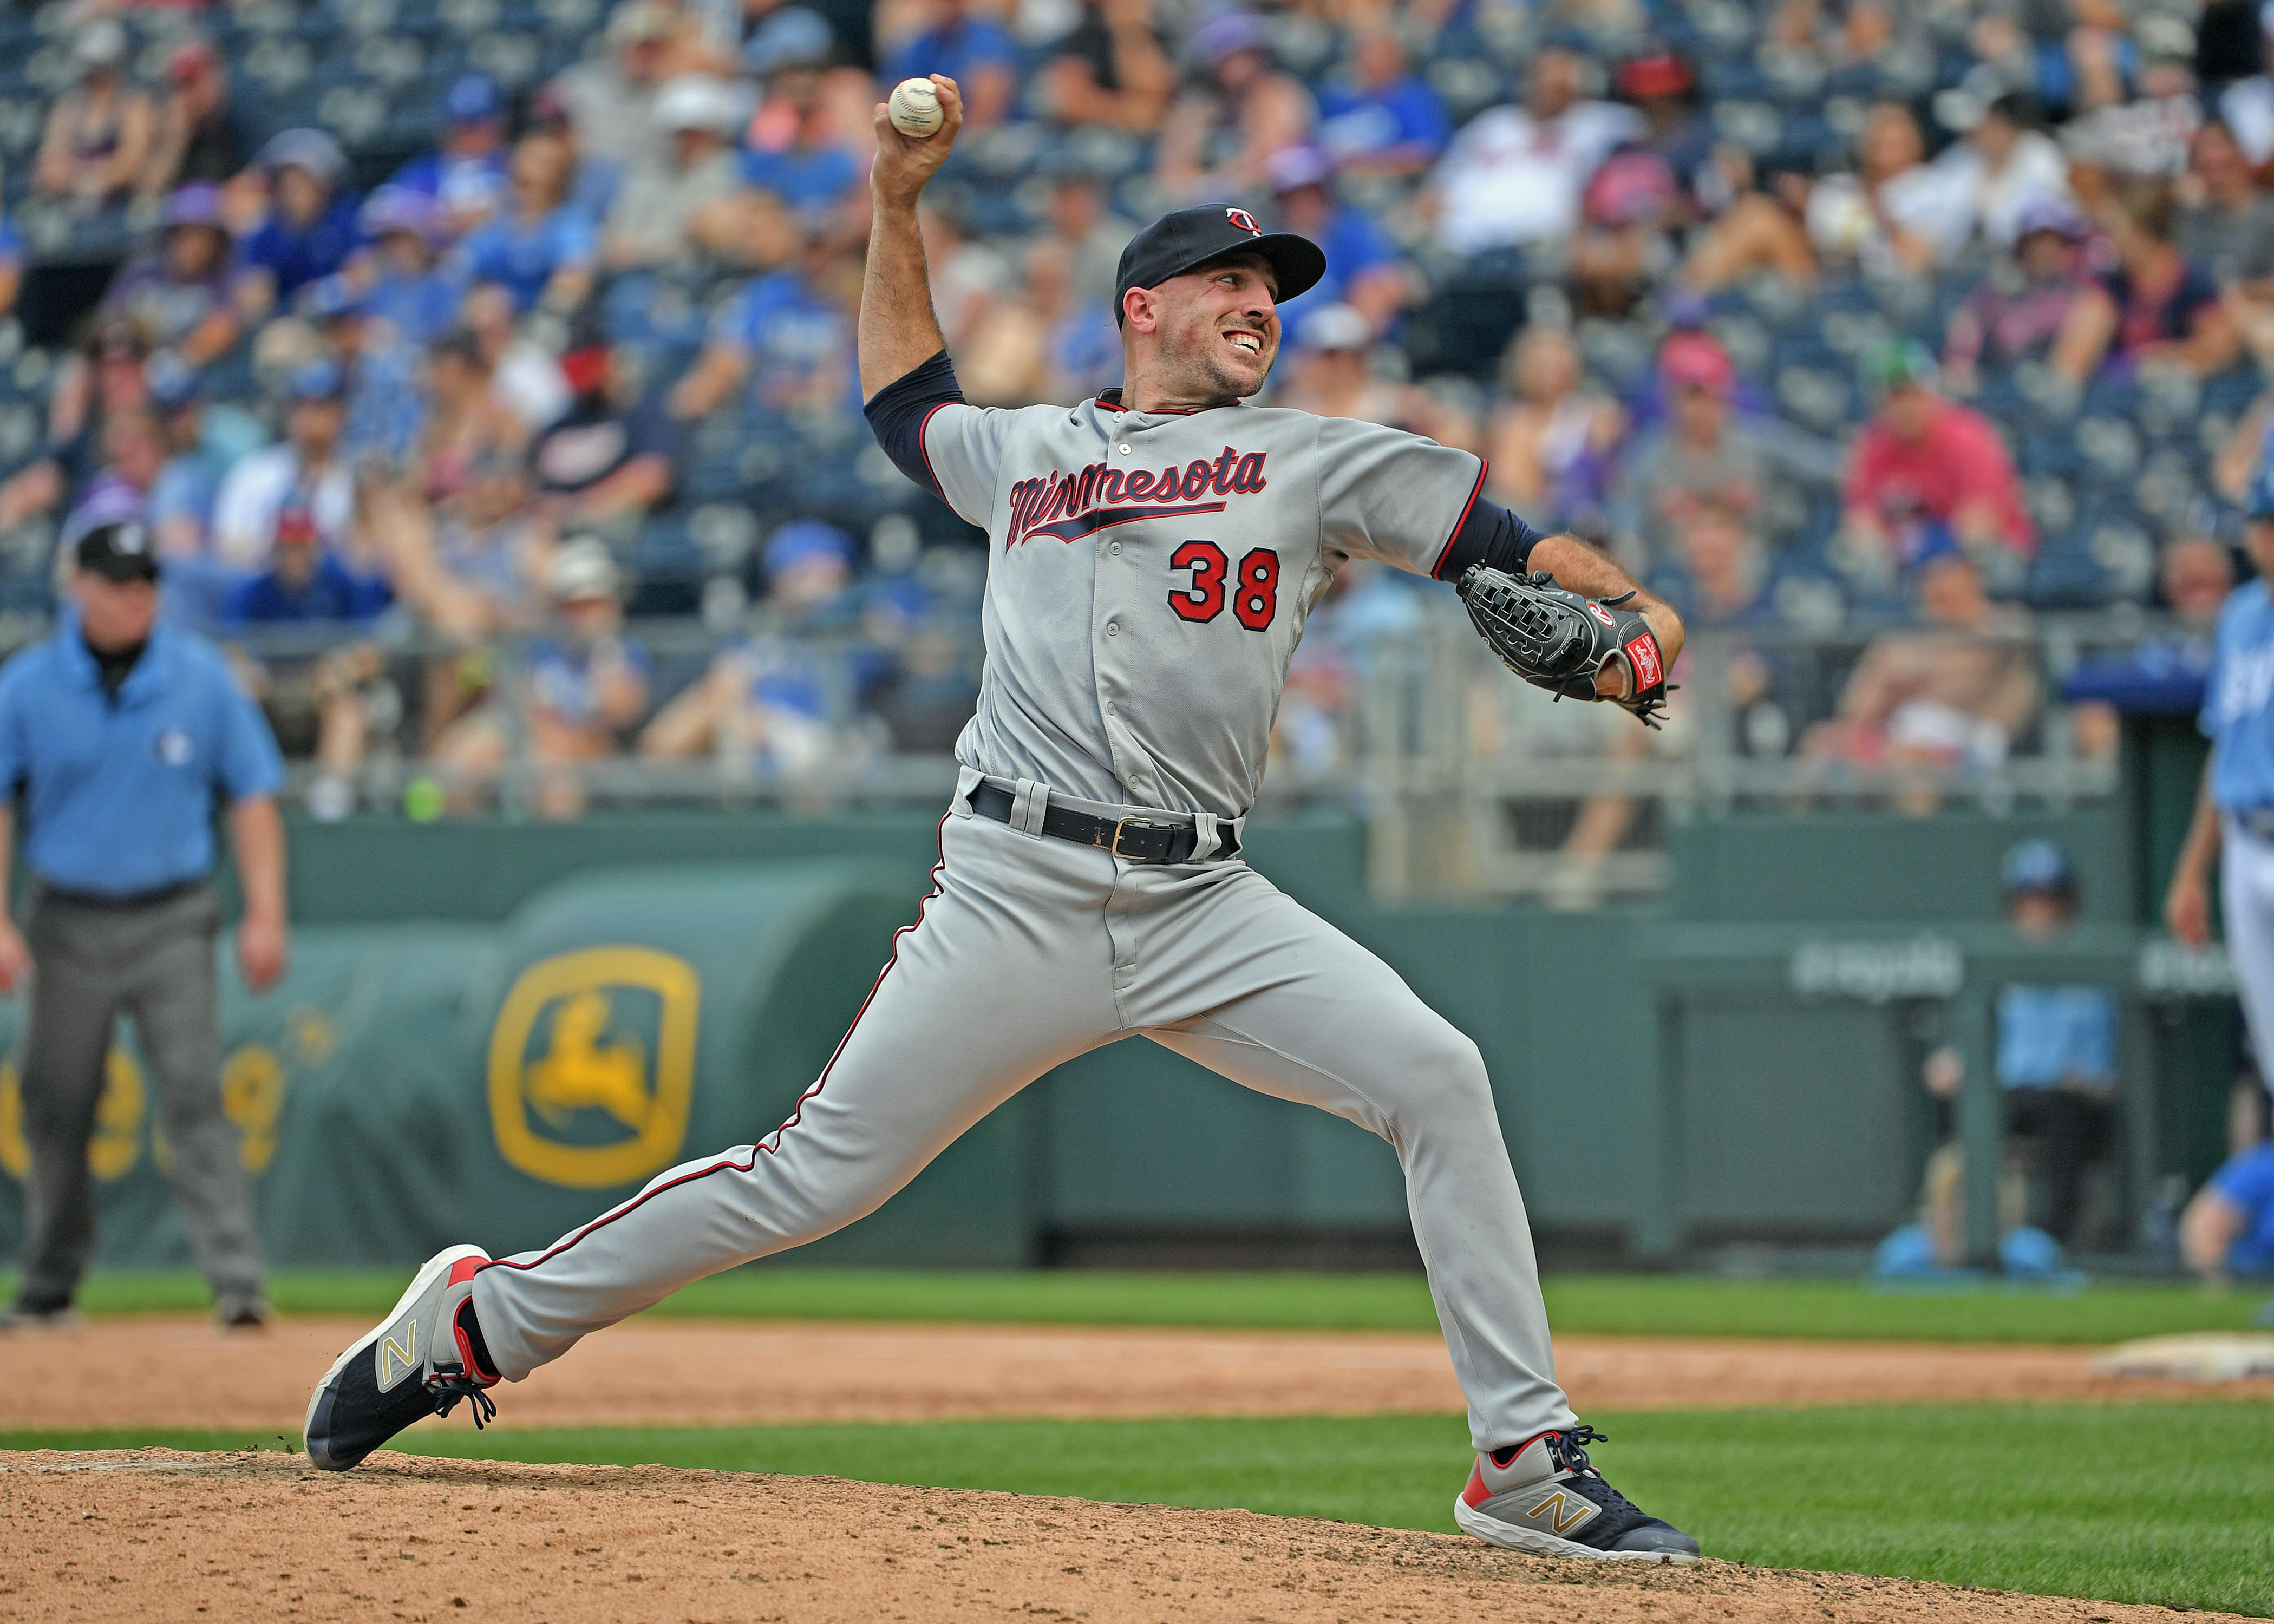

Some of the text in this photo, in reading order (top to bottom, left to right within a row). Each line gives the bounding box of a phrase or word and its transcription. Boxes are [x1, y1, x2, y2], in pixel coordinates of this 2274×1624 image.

[1005, 445, 1267, 554] Minnesota
[1167, 540, 1280, 632] 38
[1635, 644, 1655, 684] Rawlings
